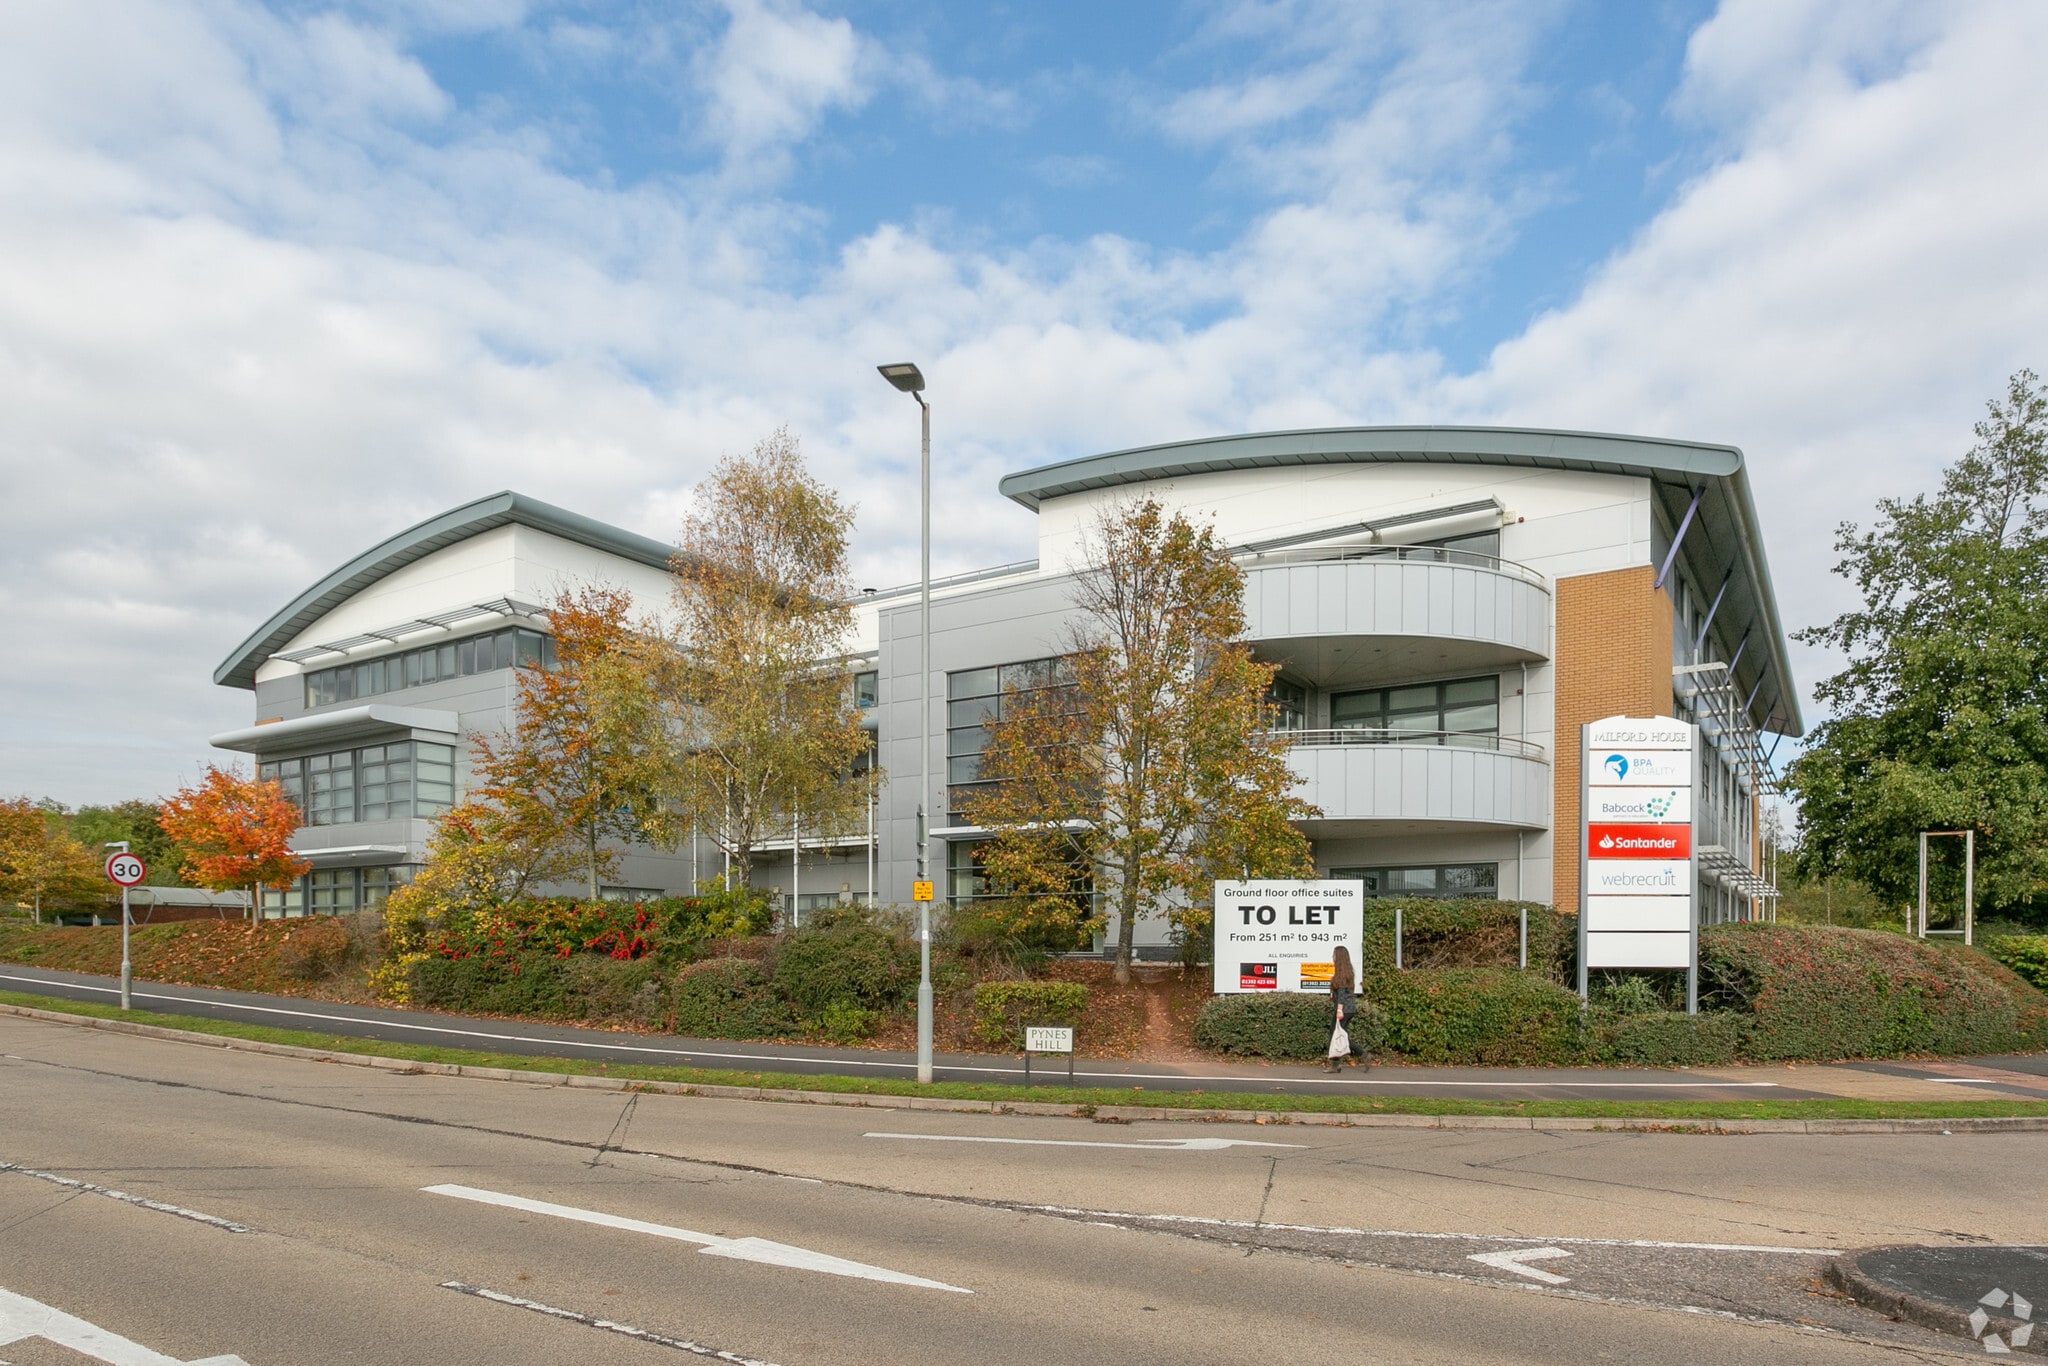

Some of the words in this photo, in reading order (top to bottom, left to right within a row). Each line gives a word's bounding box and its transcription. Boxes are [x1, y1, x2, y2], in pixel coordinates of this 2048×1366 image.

[1594, 732, 1648, 742] MILFORD
[1651, 732, 1687, 743] HOUSE
[1633, 758, 1653, 767] BPA
[1632, 767, 1676, 776] QUALITY
[1602, 803, 1646, 813] Babcock
[1615, 837, 1677, 848] Santander
[114, 863, 141, 877] 30
[1602, 871, 1677, 886] webrecruit
[1224, 888, 1262, 897] Ground
[1265, 888, 1288, 897] floor
[1291, 888, 1320, 897] office
[1323, 888, 1354, 897] suites
[1238, 905, 1276, 925] TO
[1289, 906, 1340, 925] LET
[1229, 933, 1256, 942] From
[1259, 933, 1277, 942] 251
[1298, 933, 1308, 942] to
[1311, 933, 1330, 942] 943
[1262, 965, 1276, 973] JLL
[1031, 1030, 1067, 1039] PYNES
[1035, 1040, 1062, 1049] HILL
